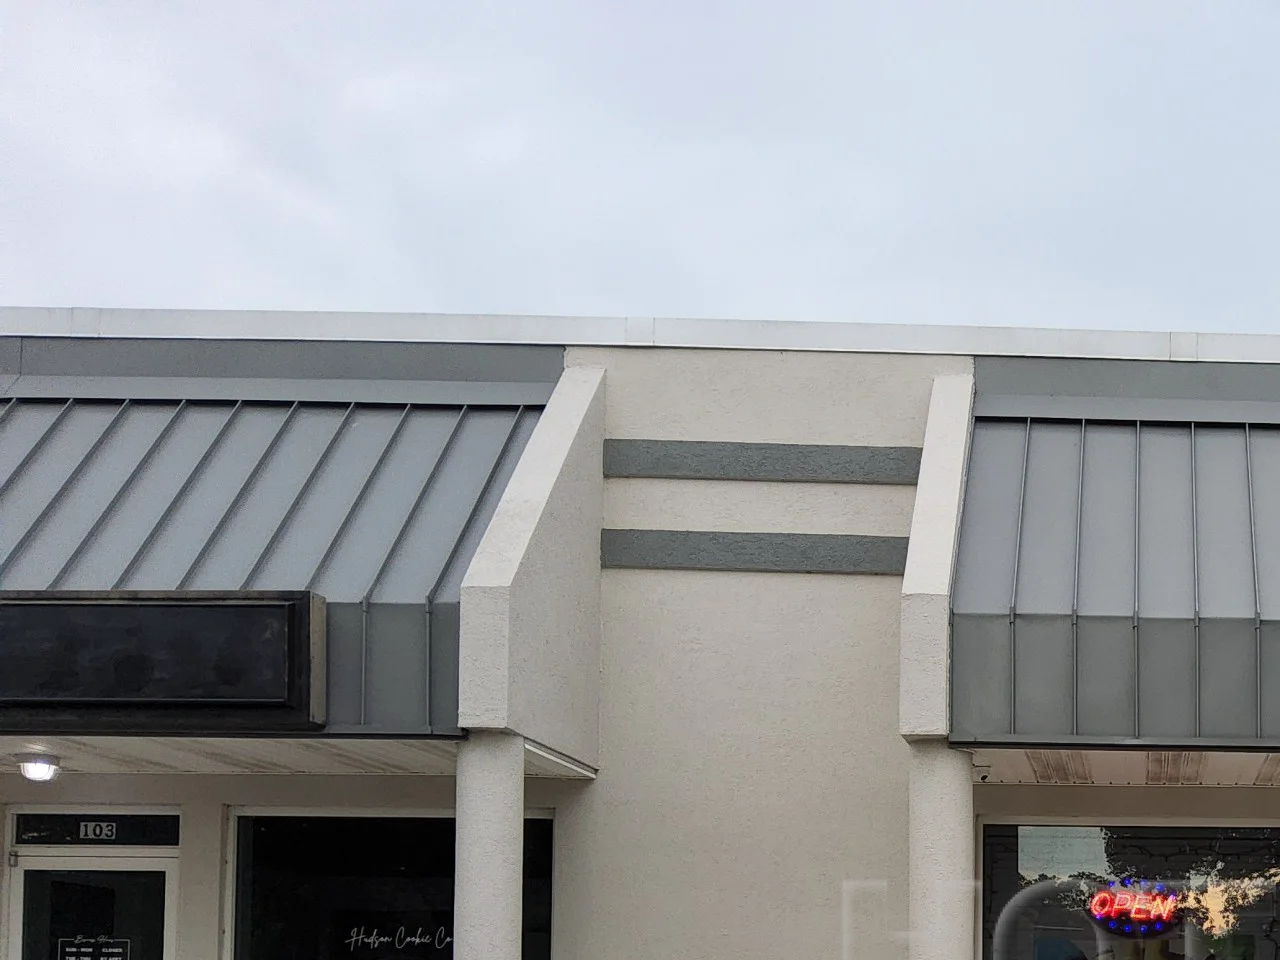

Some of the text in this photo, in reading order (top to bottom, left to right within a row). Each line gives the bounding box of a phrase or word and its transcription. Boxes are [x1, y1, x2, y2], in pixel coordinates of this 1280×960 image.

[82, 823, 114, 838] 103
[1090, 890, 1177, 921] OPEN
[344, 926, 392, 952] Hudson
[395, 926, 432, 949] Cookie
